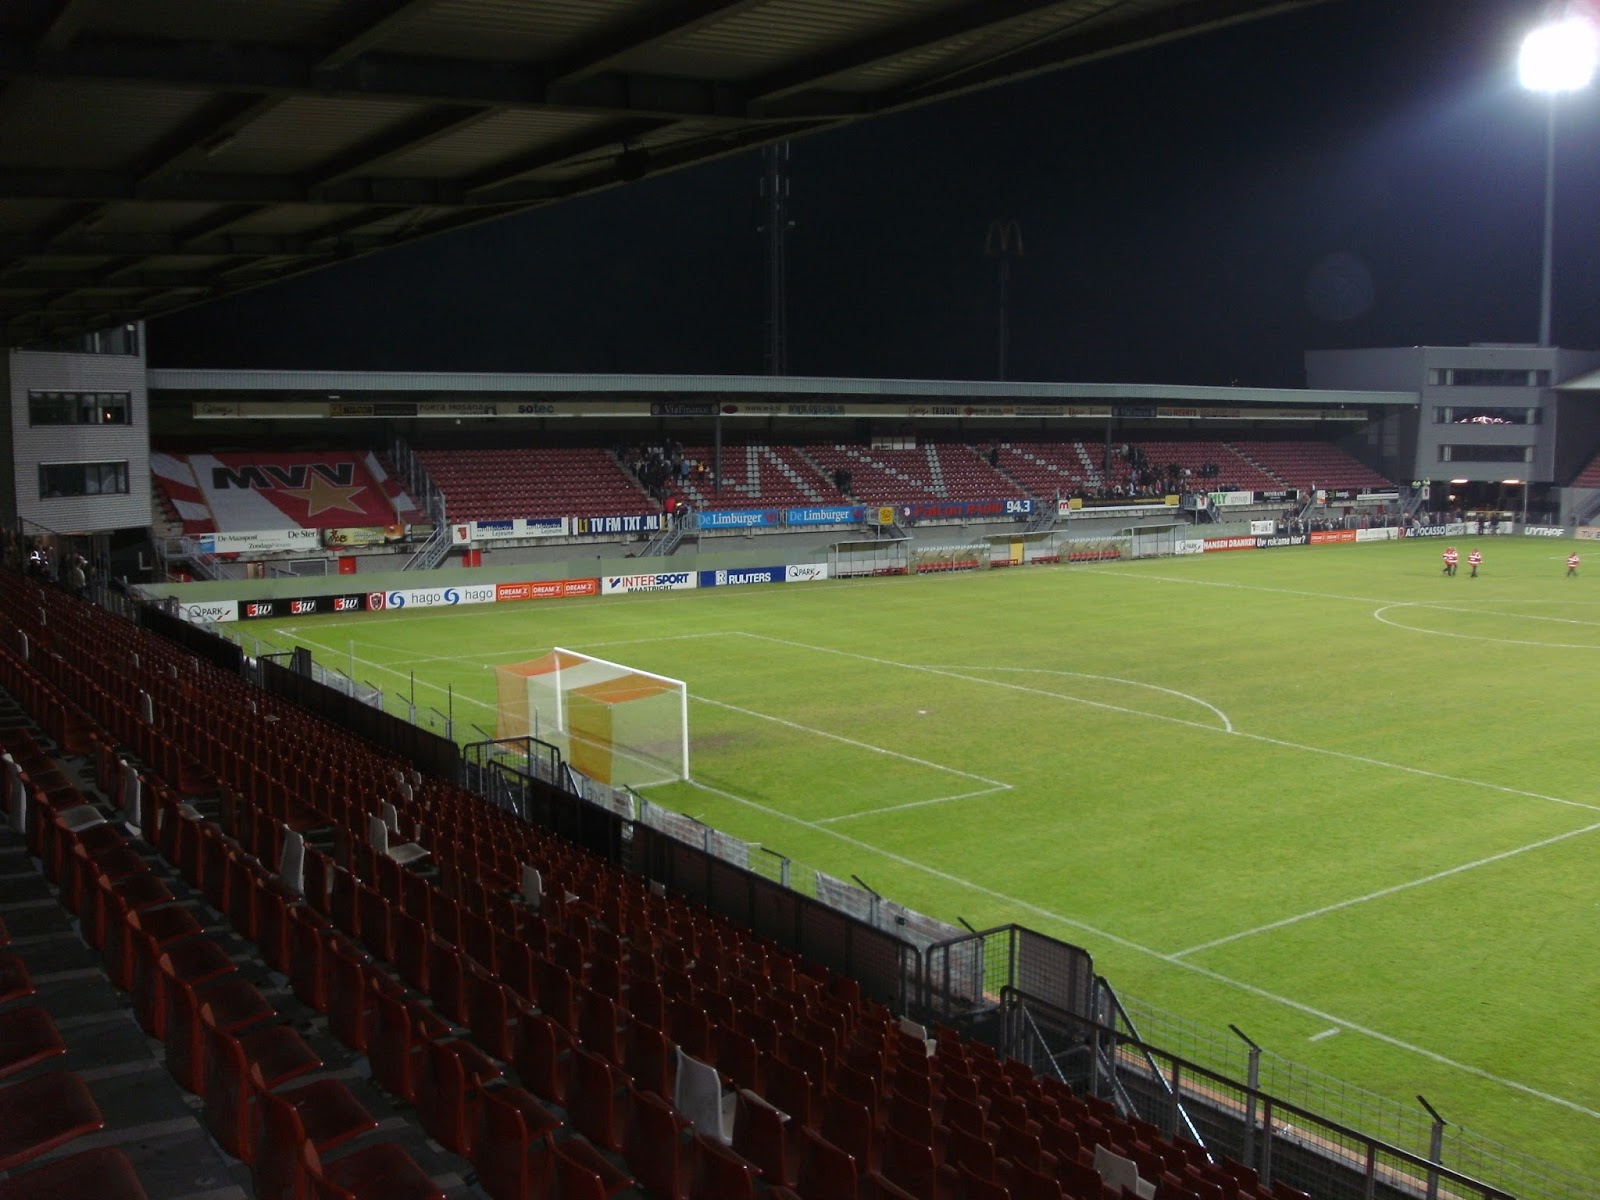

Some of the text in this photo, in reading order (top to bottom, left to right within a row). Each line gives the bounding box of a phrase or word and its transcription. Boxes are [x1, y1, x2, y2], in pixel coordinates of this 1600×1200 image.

[515, 403, 552, 414] sotec
[211, 462, 354, 489] MVV
[1006, 500, 1031, 513] 94.3
[699, 513, 762, 526] De Limburger
[790, 509, 850, 522] De Limburger
[590, 517, 604, 533] TV
[605, 517, 621, 532] FM
[623, 516, 642, 531] TXT
[643, 515, 659, 530] .NL
[287, 530, 316, 539] De Ster
[1524, 526, 1566, 537] UYTHOF
[228, 534, 258, 543] Maaspost
[1203, 538, 1256, 550] HANSEN DRANKEN
[1290, 535, 1306, 544] hier?
[622, 573, 690, 588] INTERSPORT
[728, 572, 771, 584] RUIJTERS
[627, 585, 673, 593] MAASTRICHT
[411, 593, 441, 606] hago
[465, 590, 493, 603] hago
